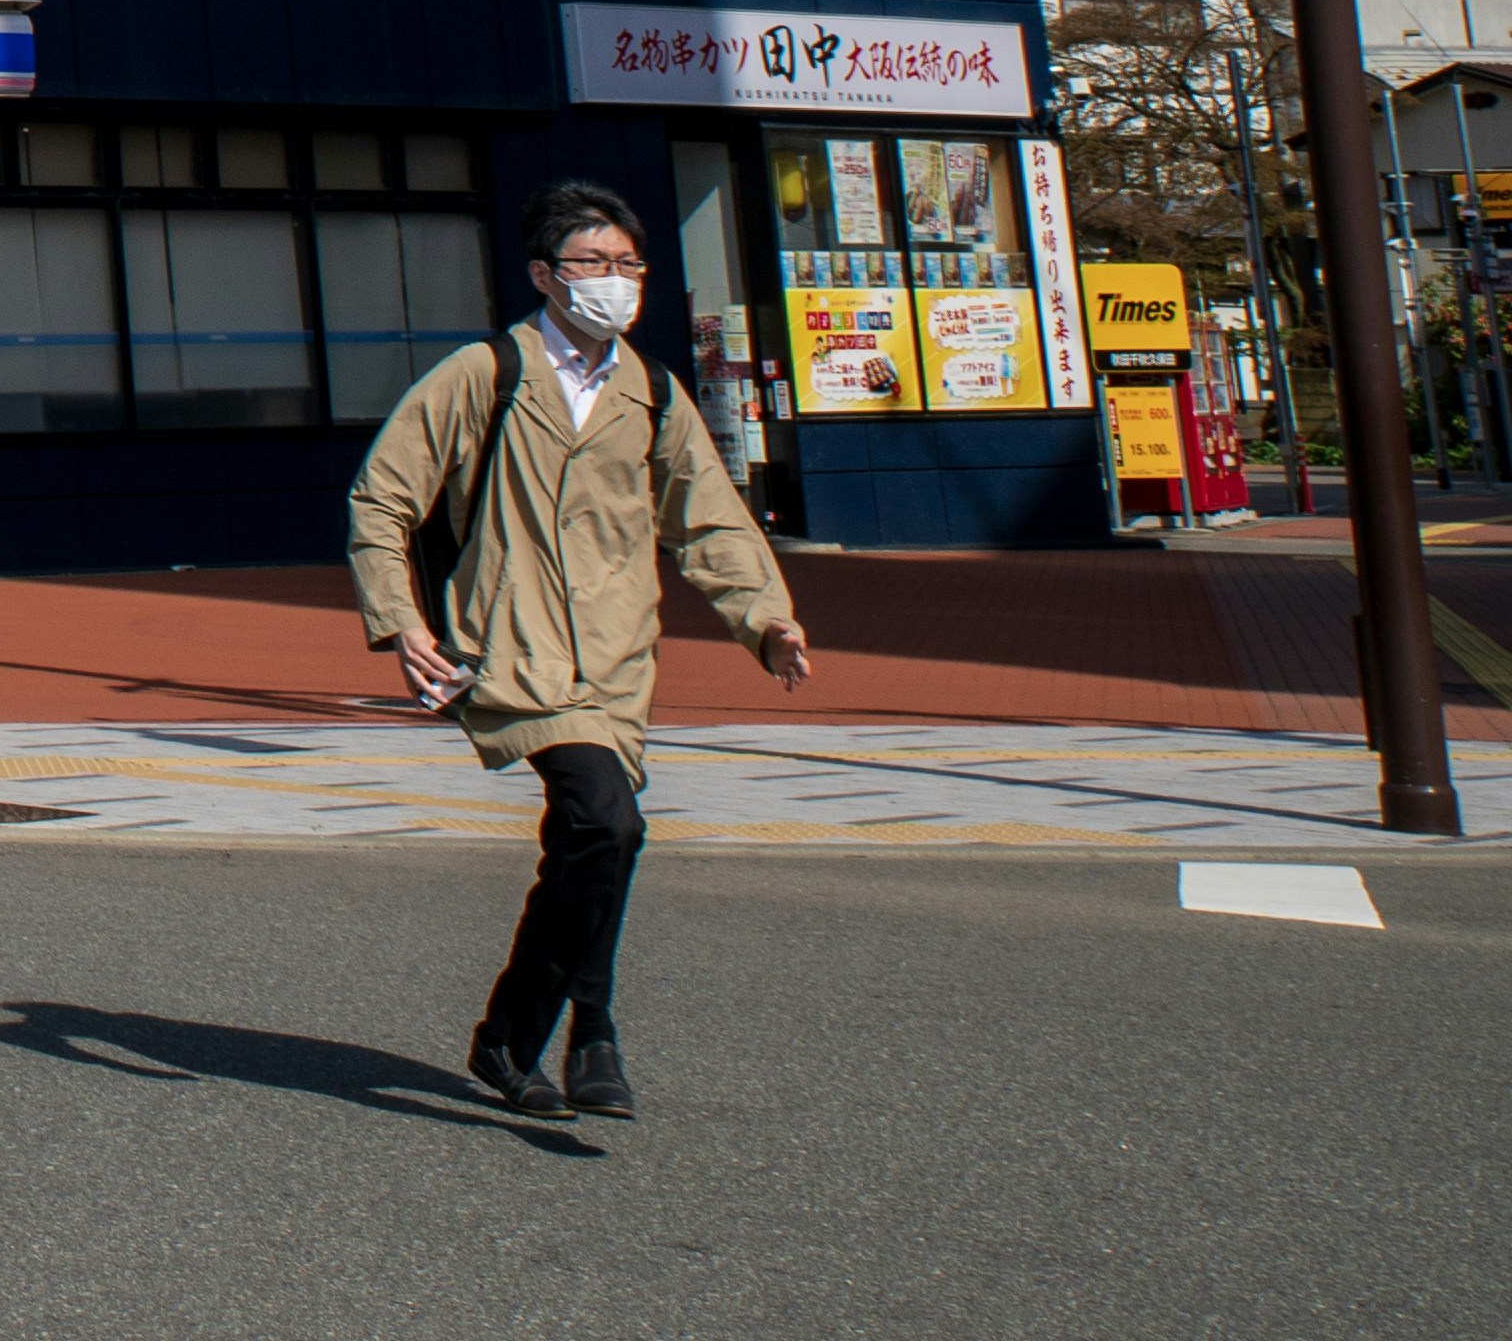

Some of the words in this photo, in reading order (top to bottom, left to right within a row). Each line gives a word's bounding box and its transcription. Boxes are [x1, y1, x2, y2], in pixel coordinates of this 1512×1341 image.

[611, 27, 749, 74] 名物串カツ
[759, 23, 841, 88] 田中
[844, 38, 1001, 89] 大阪伝統の味
[734, 88, 829, 103] KUSHIKATSU
[837, 92, 895, 104] TANAKA
[1097, 292, 1177, 323] Times
